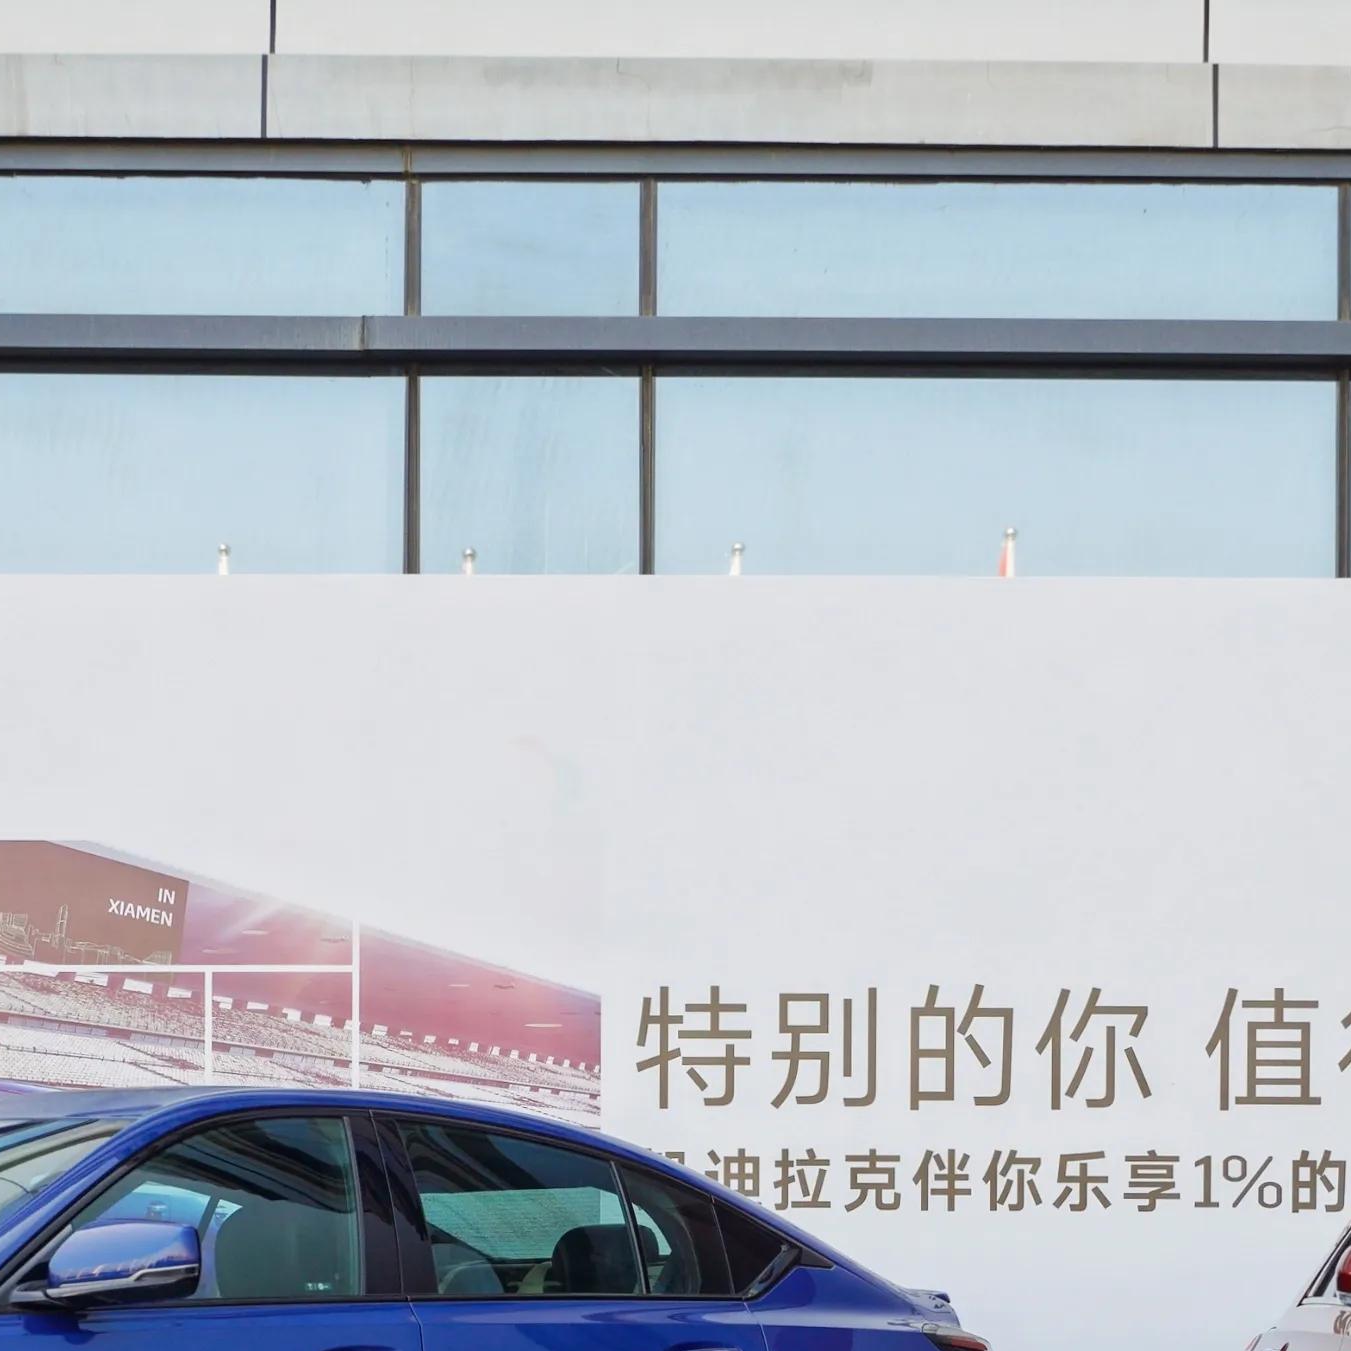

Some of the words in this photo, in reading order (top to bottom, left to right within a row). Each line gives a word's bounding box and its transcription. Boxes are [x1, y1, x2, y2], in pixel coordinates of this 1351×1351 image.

[158, 888, 175, 905] IN
[108, 898, 173, 927] XIAMEN
[636, 984, 1153, 1111] 特别的你
